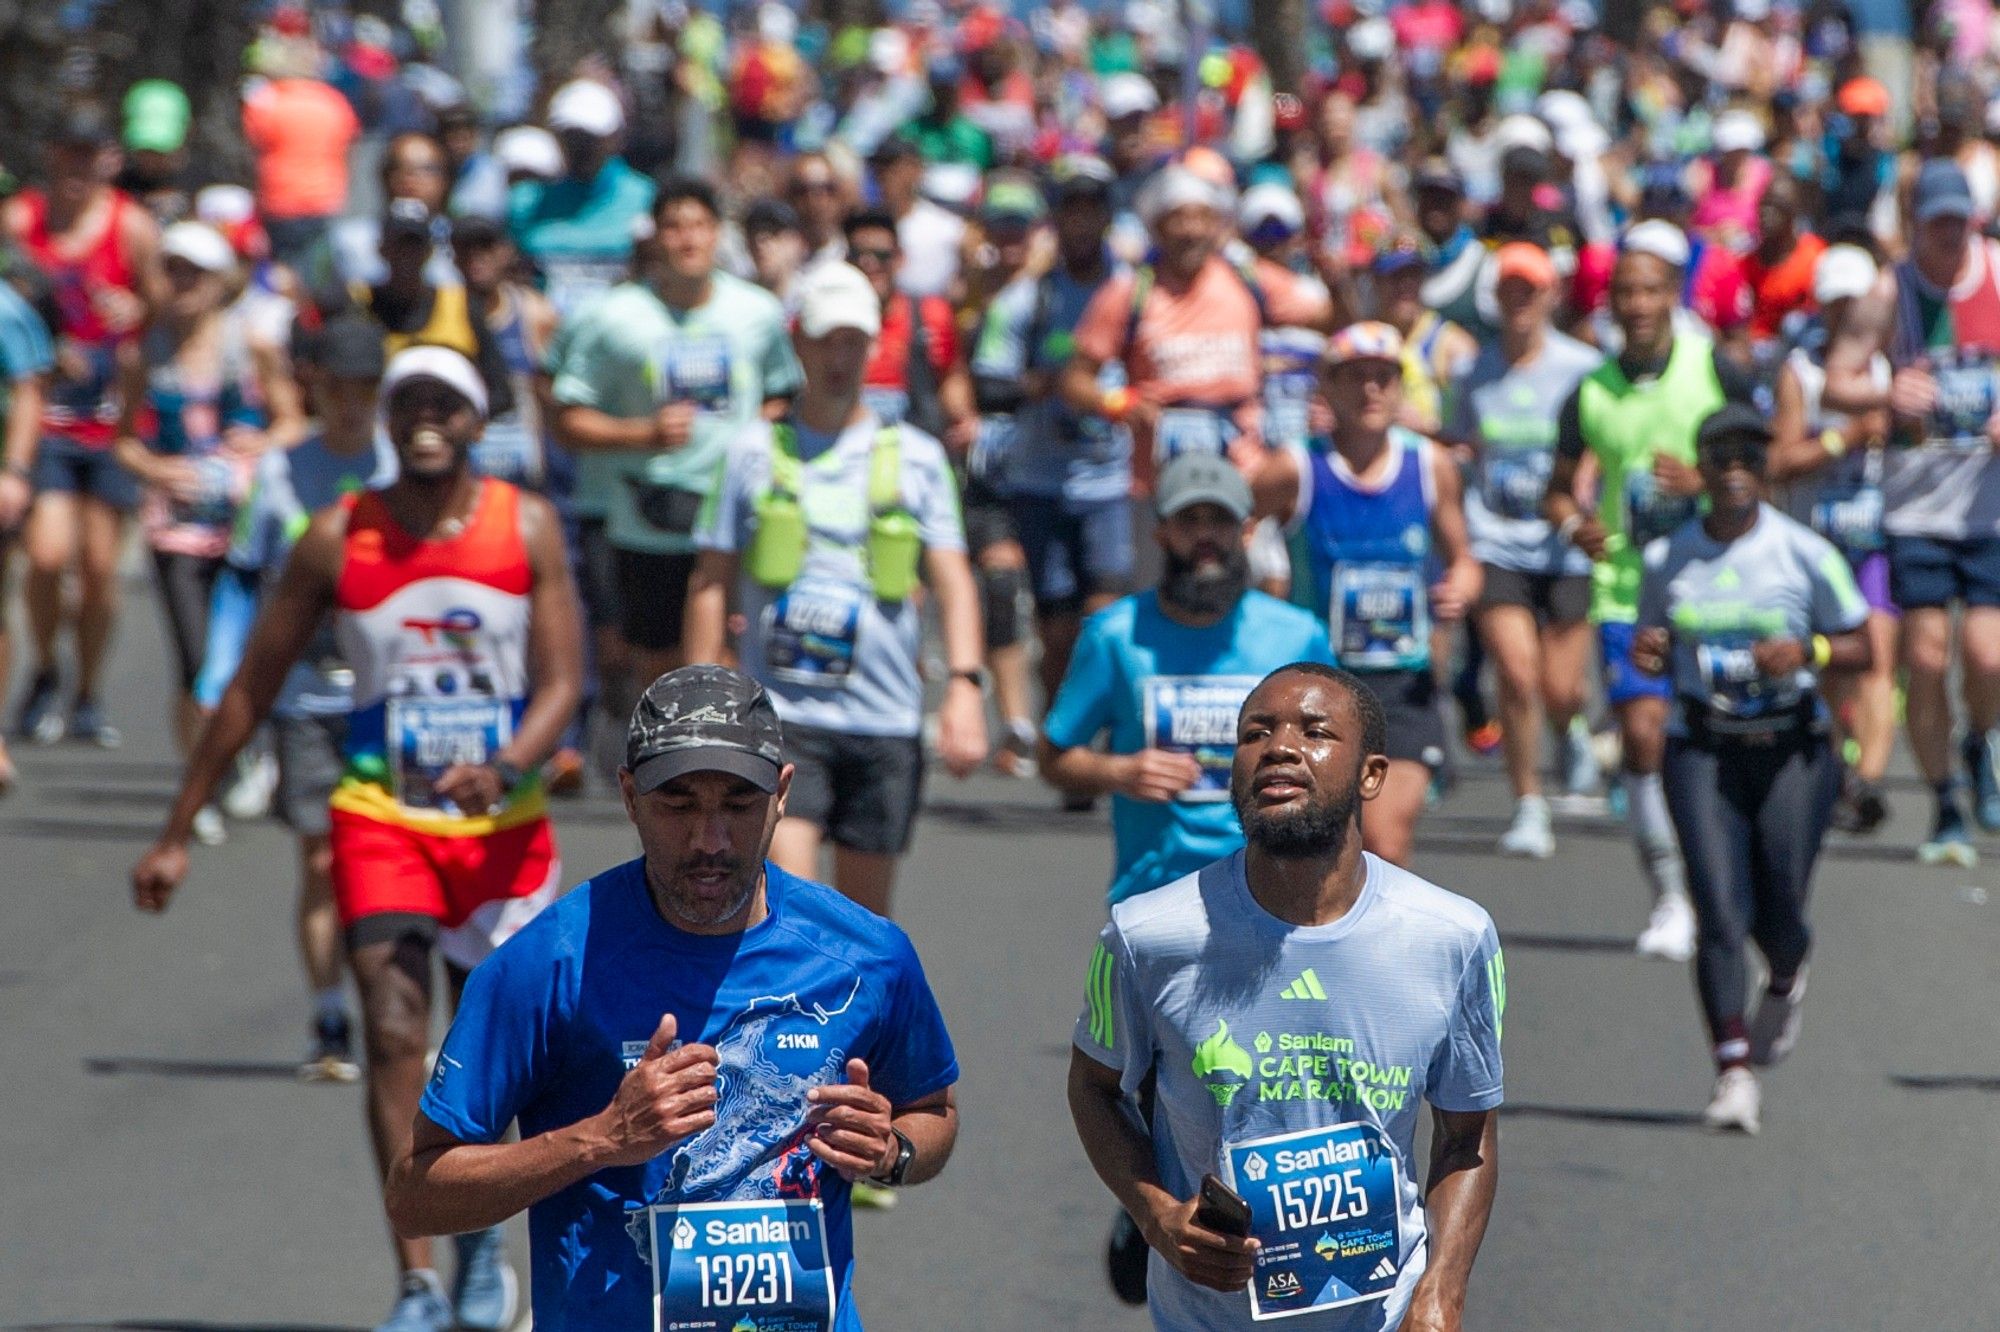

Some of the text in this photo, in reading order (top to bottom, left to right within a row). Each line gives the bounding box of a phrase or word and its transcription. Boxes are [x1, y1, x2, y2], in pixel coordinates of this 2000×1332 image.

[776, 1034, 819, 1049] 21KM
[1278, 1033, 1353, 1053] Sanlam
[1258, 1056, 1412, 1088] CAPE TOWN
[1258, 1079, 1406, 1111] MARATHON
[1275, 1137, 1378, 1173] Sanlam
[1267, 1168, 1369, 1232] 15225
[705, 1215, 811, 1246] Sanlam
[1340, 1236, 1366, 1248] CAPE
[1367, 1230, 1393, 1242] TOWN
[1341, 1239, 1393, 1258] MARATHON
[695, 1252, 792, 1307] 13231
[1268, 1272, 1299, 1290] ASA
